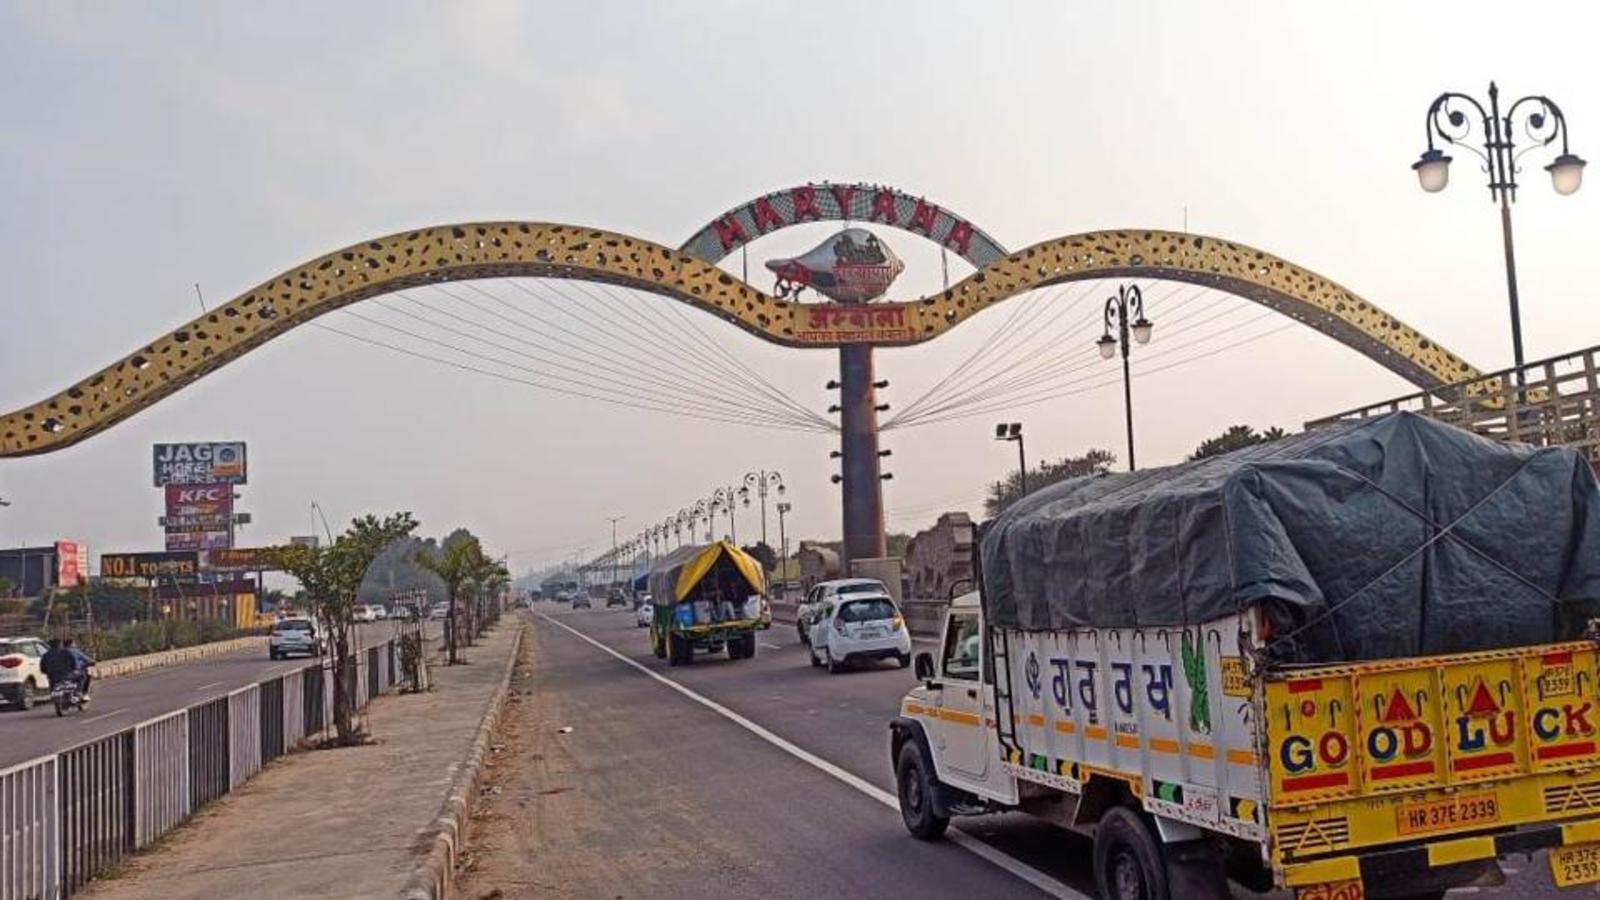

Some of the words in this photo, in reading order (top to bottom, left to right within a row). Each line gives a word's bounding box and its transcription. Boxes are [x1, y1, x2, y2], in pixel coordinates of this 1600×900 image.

[709, 183, 974, 257] HARYANA
[159, 445, 213, 462] JAG
[178, 488, 220, 503] KFC
[1279, 720, 1434, 774] GOOD
[1455, 701, 1594, 752] LUCK
[1408, 808, 1427, 828] HR
[1429, 804, 1457, 826] 37E
[1460, 799, 1496, 821] 2339
[1564, 861, 1598, 882] 2339
